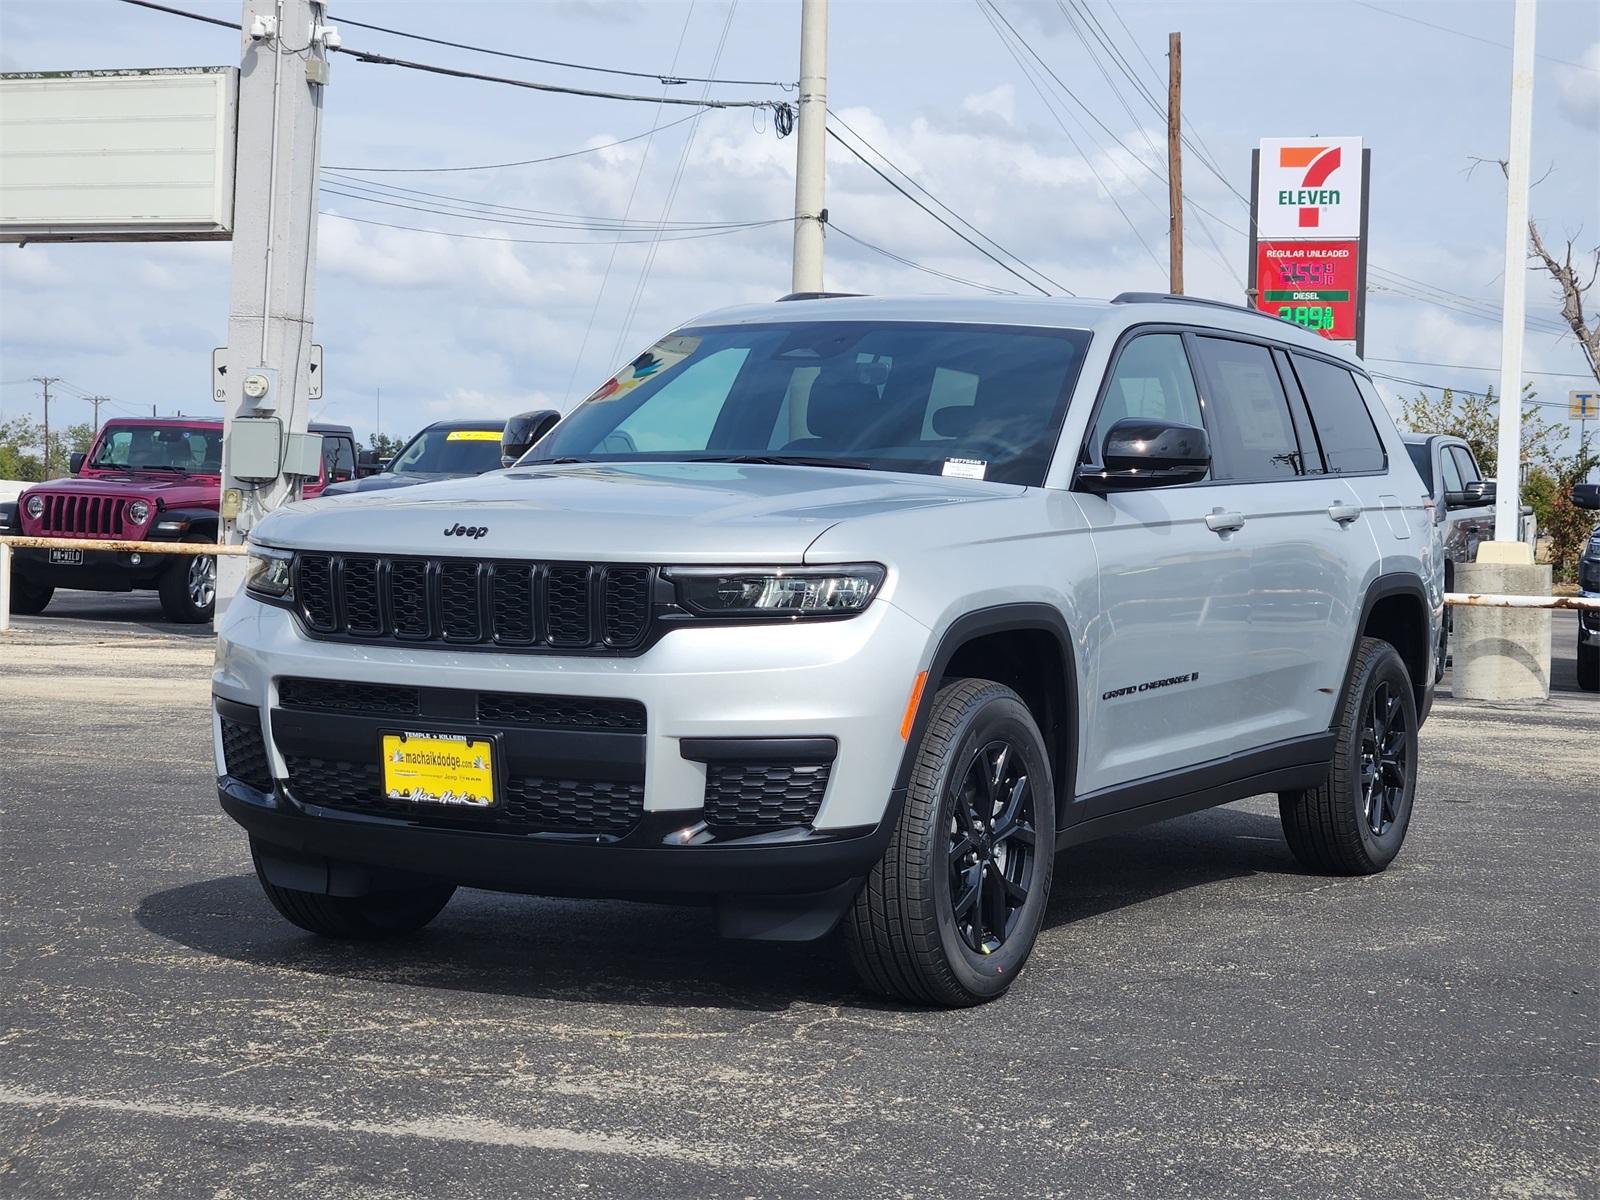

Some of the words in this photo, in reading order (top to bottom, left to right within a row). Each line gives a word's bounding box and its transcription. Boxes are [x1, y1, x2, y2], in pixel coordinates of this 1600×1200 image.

[1266, 249, 1305, 259] REGULAR
[1306, 249, 1350, 258] UNLEADED
[1293, 292, 1320, 300] DIESEL
[443, 522, 489, 540] Jeep
[1102, 686, 1137, 700] GRAND
[1138, 673, 1191, 692] CHEROKEE
[405, 751, 473, 771] machaikdodge.com
[409, 787, 434, 802] Mac
